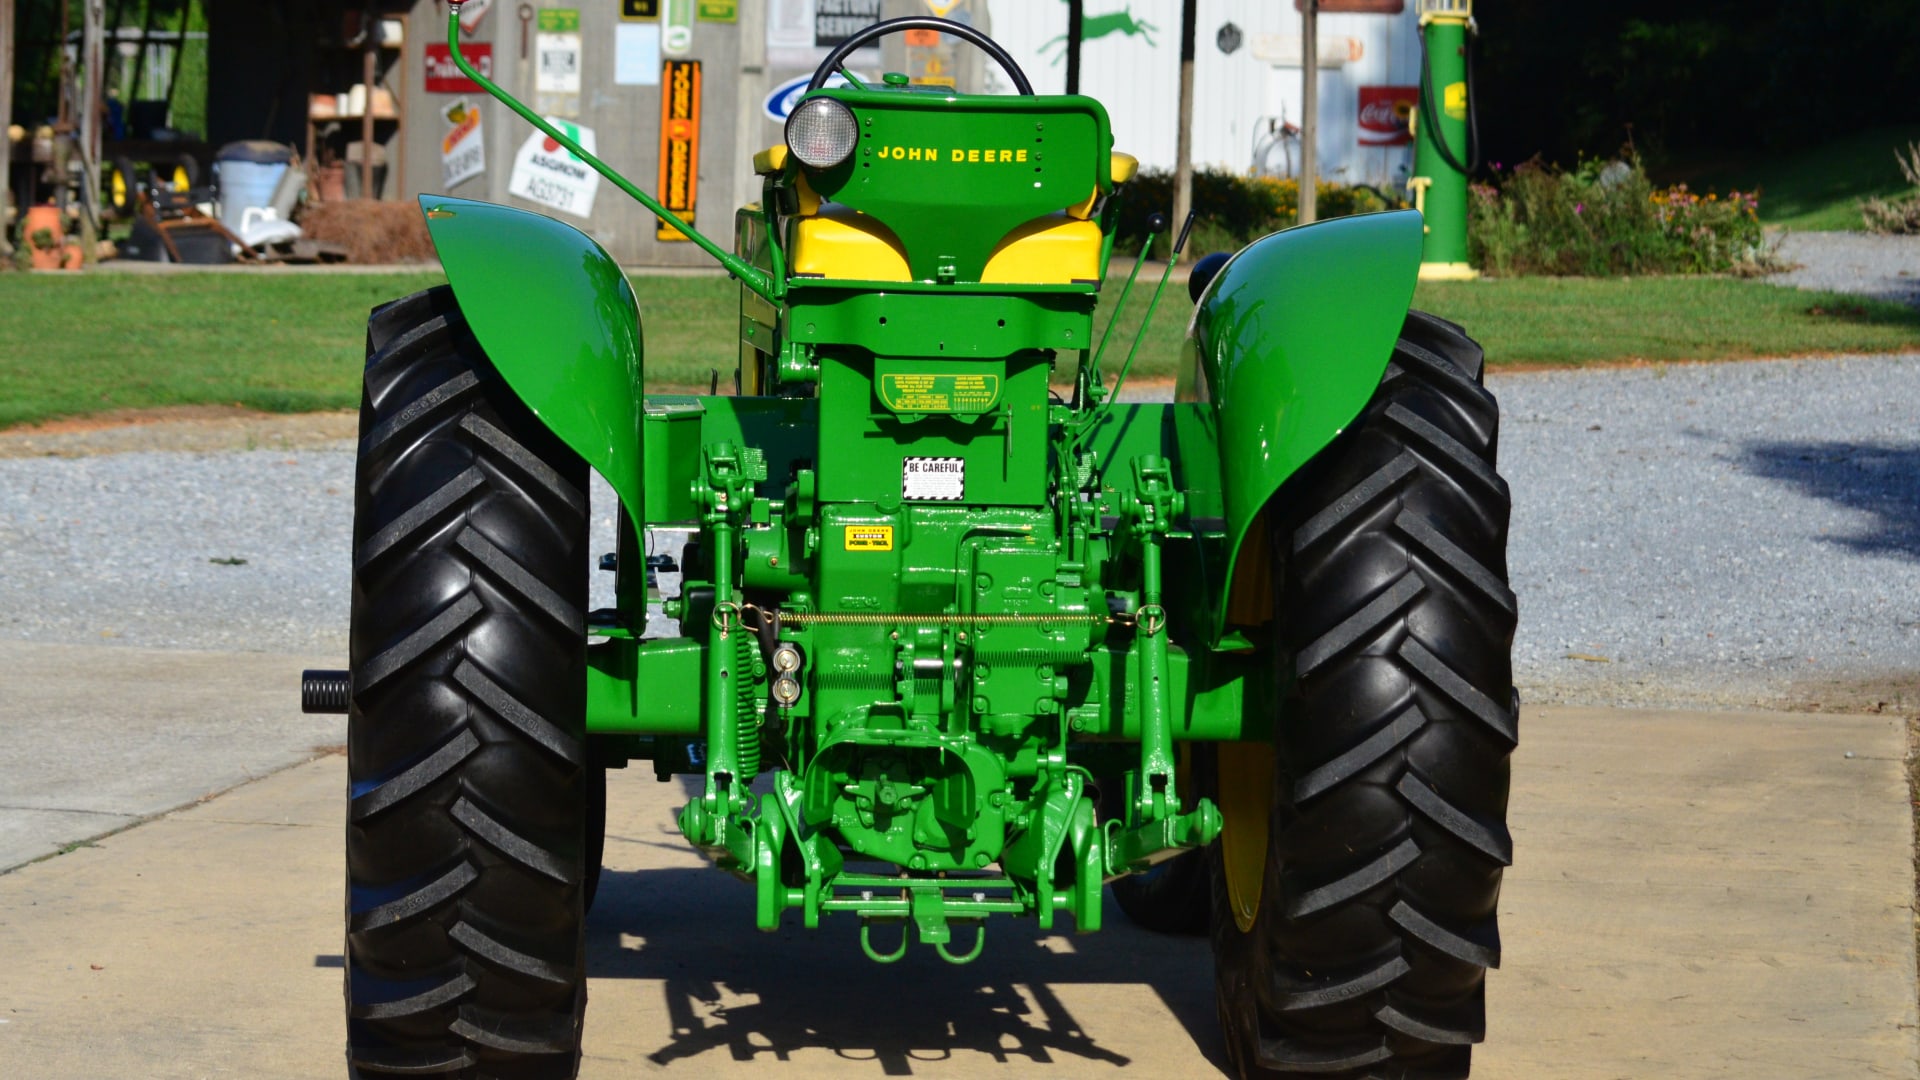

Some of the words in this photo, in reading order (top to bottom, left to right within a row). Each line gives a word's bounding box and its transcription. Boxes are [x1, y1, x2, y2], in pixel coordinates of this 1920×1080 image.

[878, 146, 937, 161] JOHN
[952, 149, 1028, 162] DEERE
[909, 462, 919, 472] BE
[922, 462, 959, 473] CAREFUL
